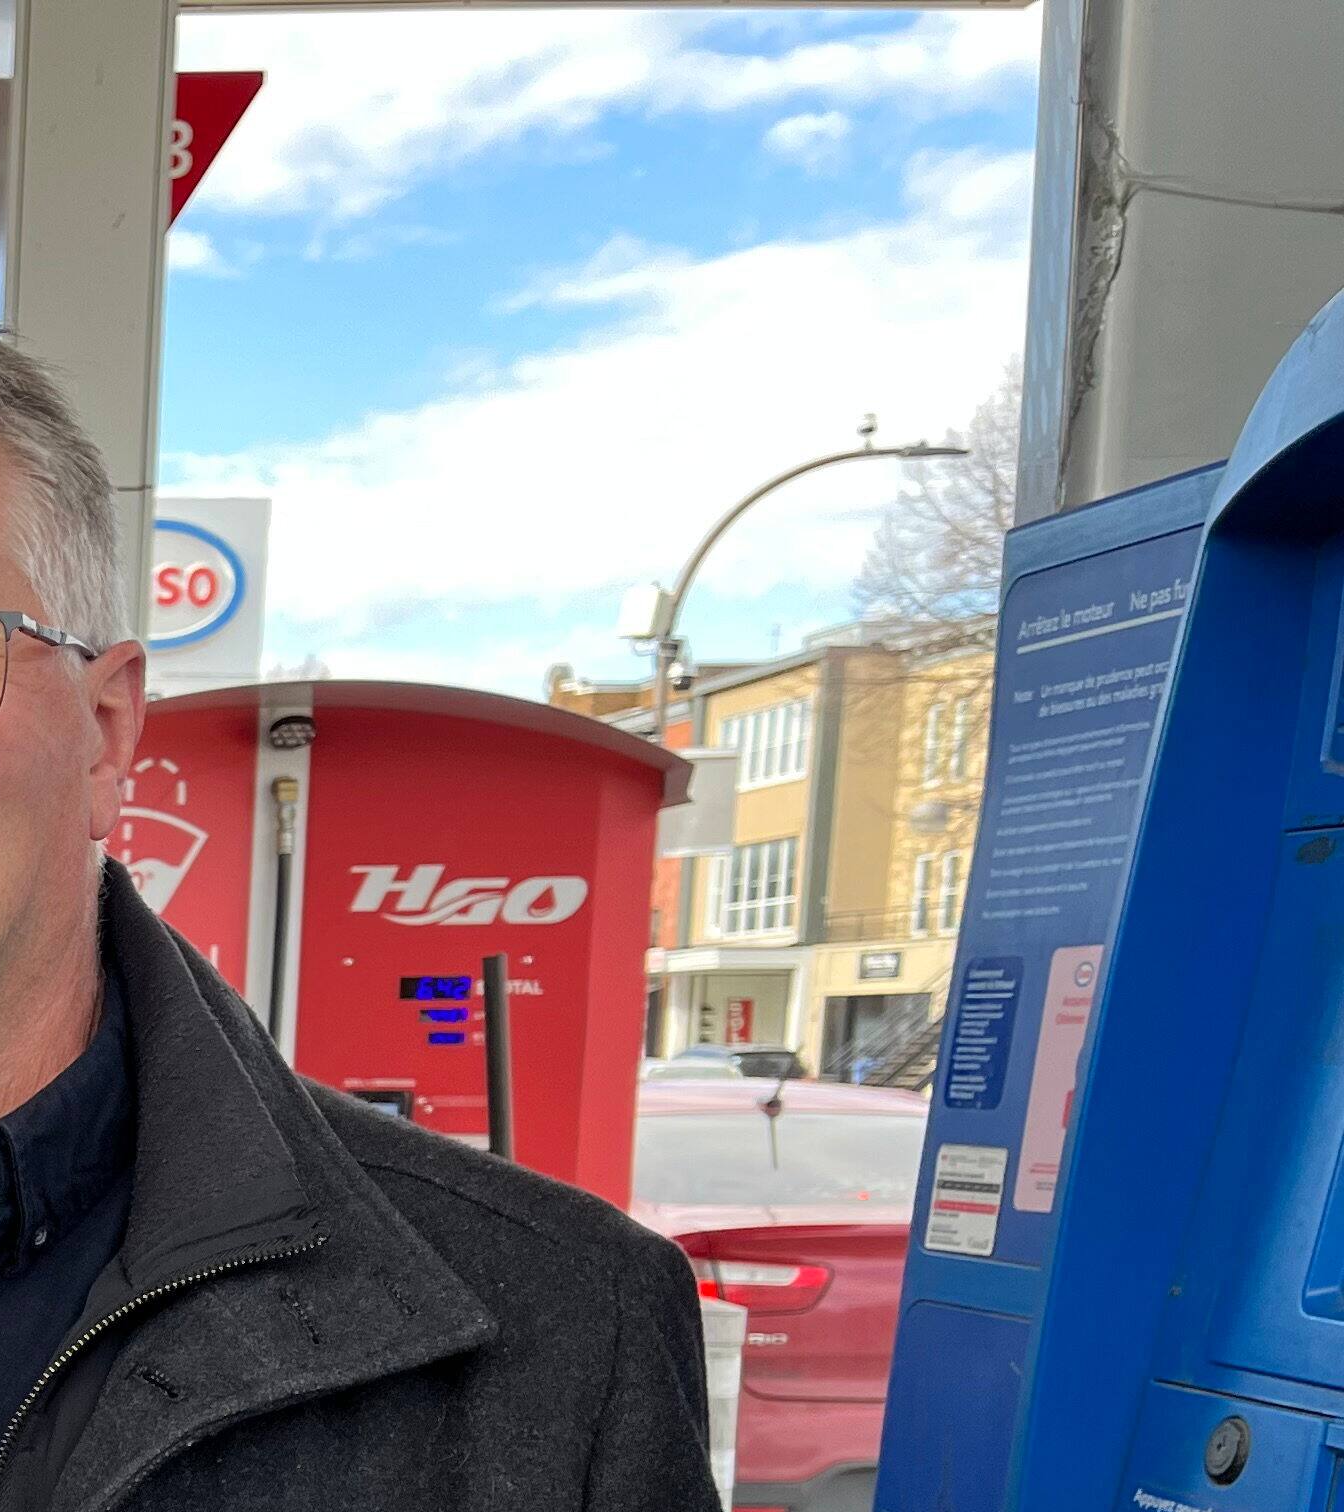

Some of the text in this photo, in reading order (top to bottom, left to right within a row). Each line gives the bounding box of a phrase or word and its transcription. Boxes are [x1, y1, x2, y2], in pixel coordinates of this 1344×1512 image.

[1129, 577, 1190, 613] Ne pas fu
[1072, 602, 1116, 624] moteur
